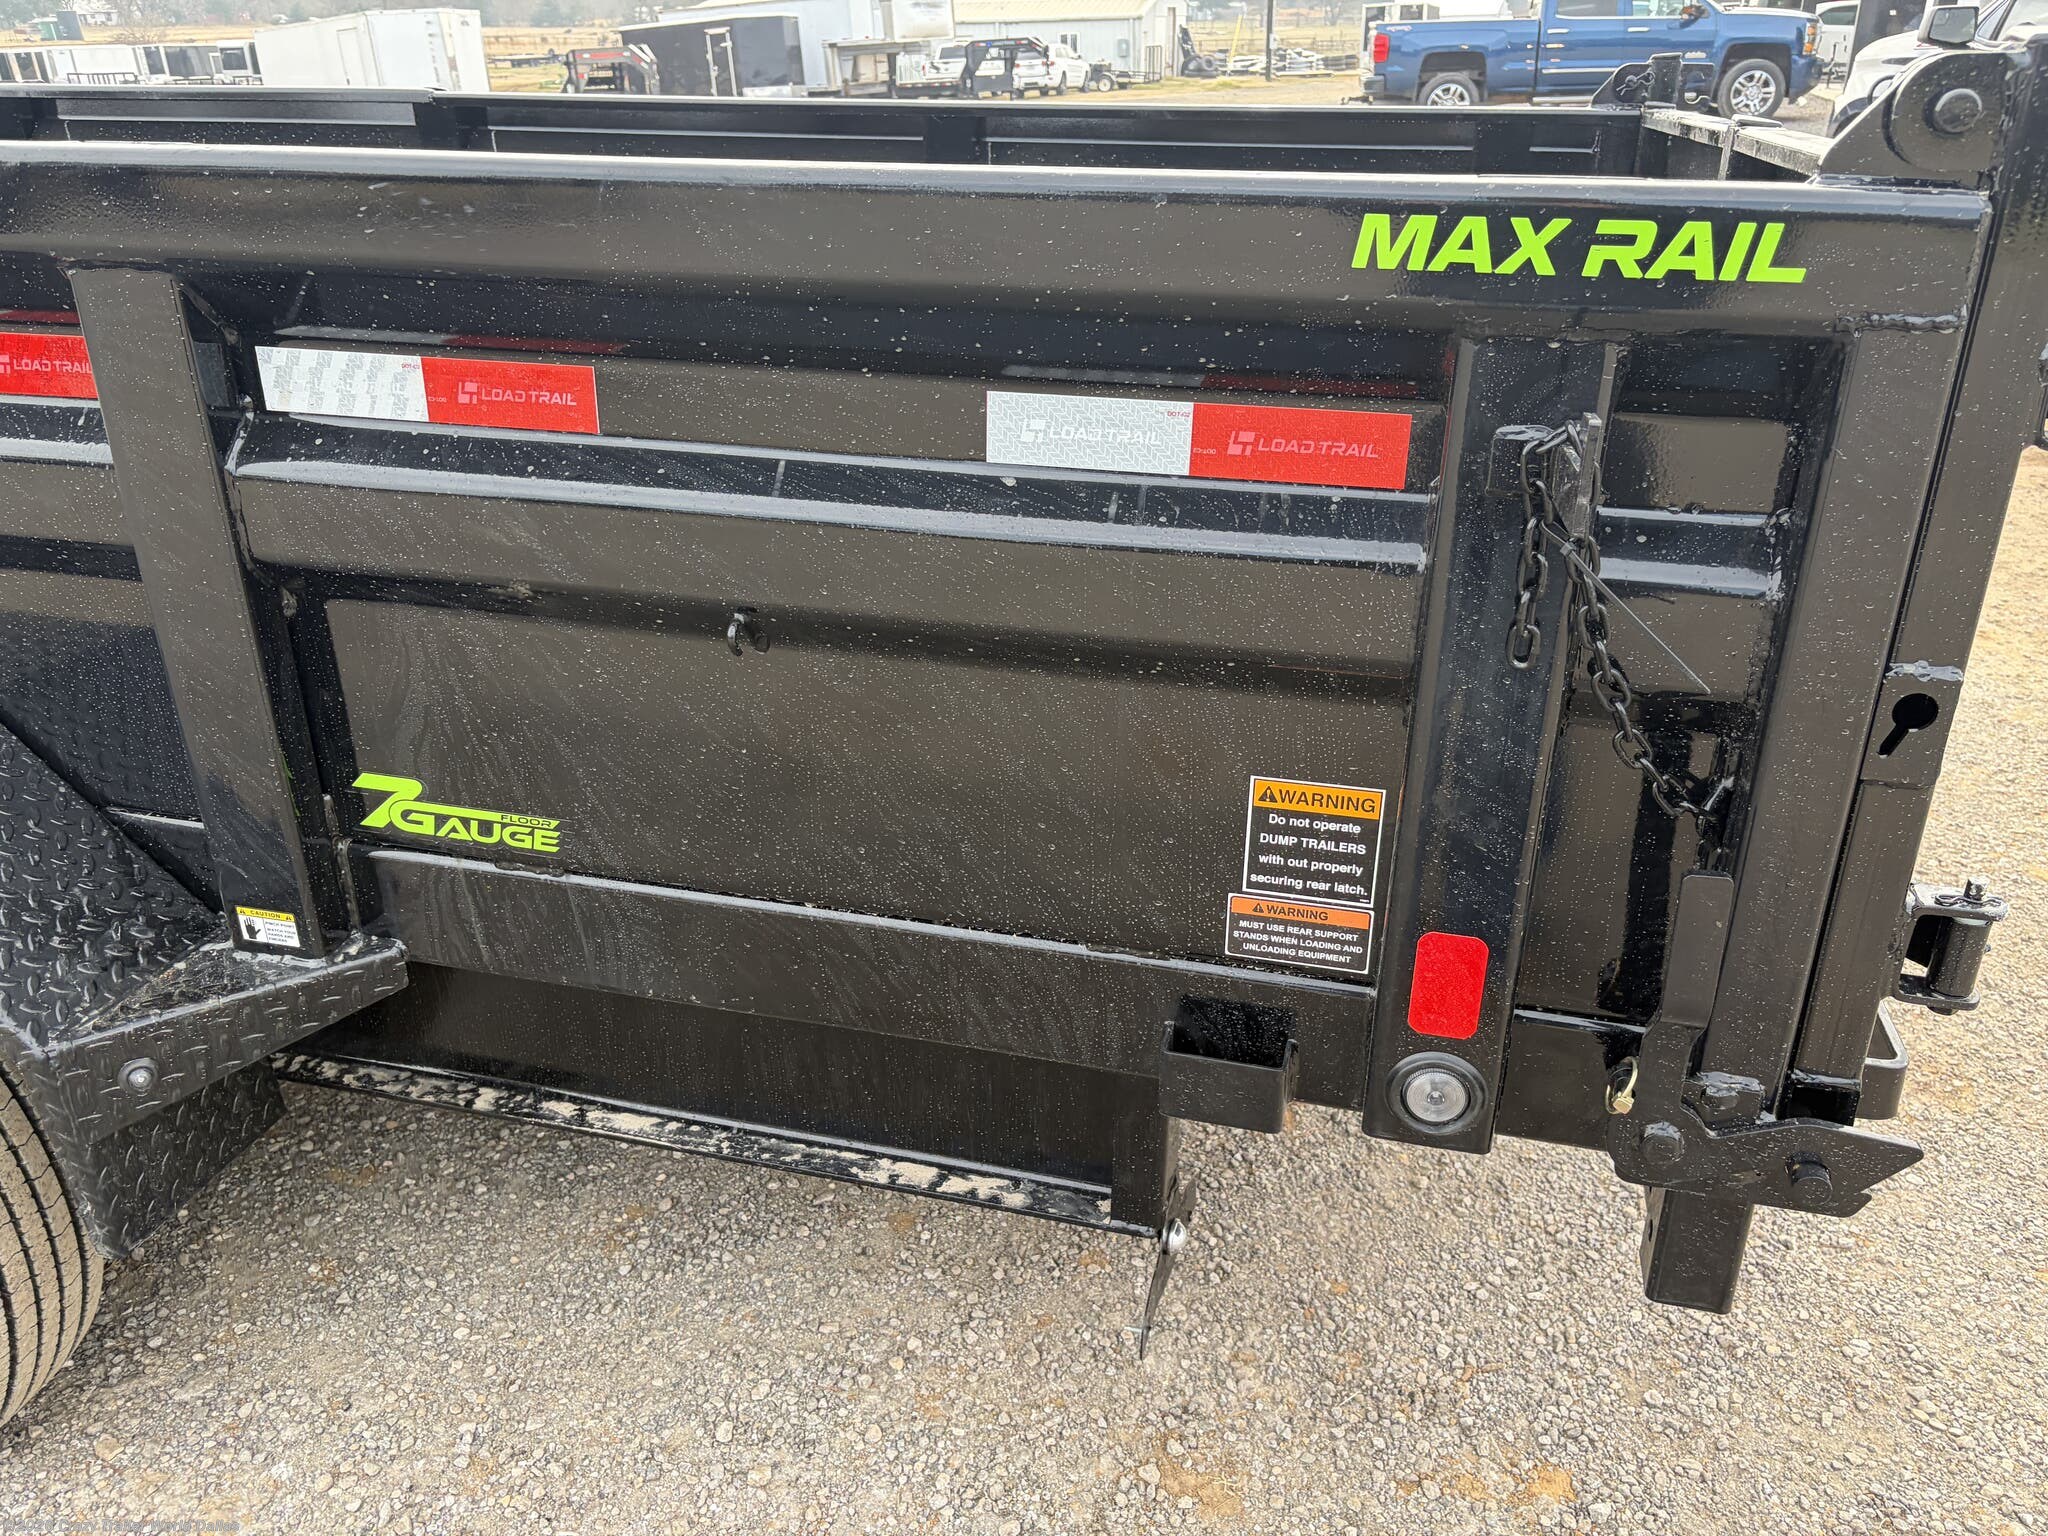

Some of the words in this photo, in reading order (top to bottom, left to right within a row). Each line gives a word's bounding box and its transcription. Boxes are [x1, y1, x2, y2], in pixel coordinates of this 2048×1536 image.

[1351, 213, 1571, 276] MAX
[1581, 219, 1807, 284] RAIL
[13, 358, 51, 372] LOAD
[53, 360, 93, 374] TRAIL
[481, 388, 526, 403] LOAD
[529, 391, 577, 406] TRAIL
[1049, 426, 1102, 442] LOAD
[1104, 429, 1162, 445] TRAIL
[1257, 437, 1315, 454] LOAD
[1319, 441, 1379, 459] TRAIL
[1279, 788, 1376, 814] WARNING
[389, 800, 561, 853] GAUGE
[500, 814, 552, 828] FLOOR
[1268, 813, 1286, 825] Do
[1289, 817, 1310, 828] not
[1312, 820, 1361, 834] operate
[1260, 832, 1298, 847] DUMP
[1300, 837, 1367, 855] TRAILERS
[1258, 854, 1284, 865] with
[1287, 857, 1308, 868] out
[1310, 860, 1363, 877] properly
[1250, 873, 1303, 889] securing
[1306, 880, 1331, 891] rear
[1334, 882, 1368, 896] latch.
[250, 909, 281, 919] CAUTION
[1266, 904, 1329, 921] WARNING
[1233, 930, 1269, 941] STANDS
[1270, 934, 1298, 945] WHEN
[1299, 938, 1341, 951] LOADING
[1342, 945, 1363, 954] AND
[1239, 920, 1265, 930] MUST
[1266, 923, 1285, 932] USE
[1286, 926, 1313, 936] REAR
[1314, 928, 1359, 942] SUPPORT
[1242, 942, 1296, 956] UNLOADING
[1298, 949, 1351, 963] EQUIPMENT
